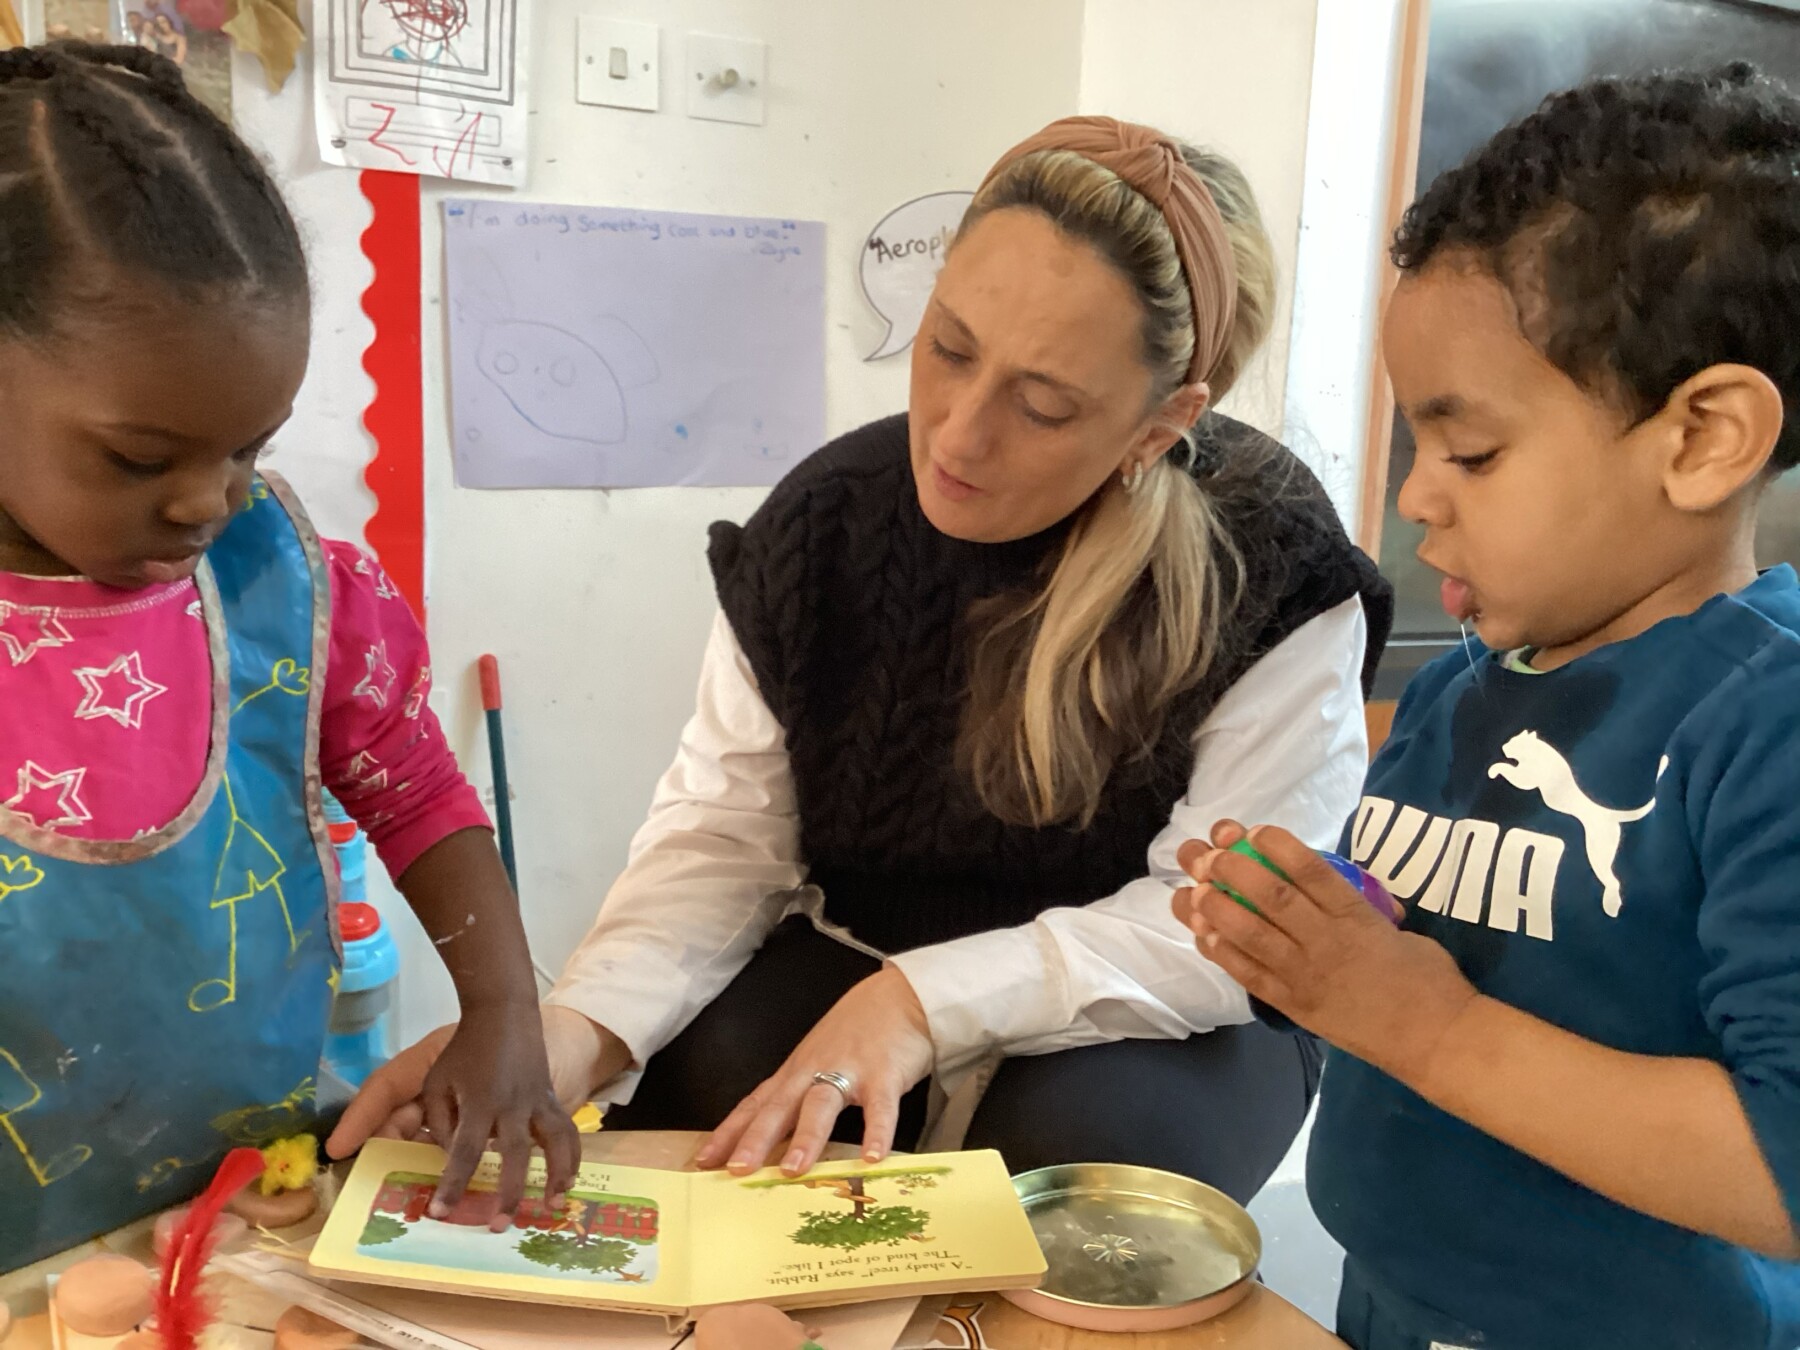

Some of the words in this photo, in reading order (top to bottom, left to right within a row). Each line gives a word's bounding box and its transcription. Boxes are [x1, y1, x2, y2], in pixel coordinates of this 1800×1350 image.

[514, 208, 570, 234] doing
[1351, 796, 1565, 941] PUMA
[830, 1256, 858, 1267] spot
[866, 1255, 881, 1266] of
[887, 1252, 918, 1263] kind
[905, 1262, 945, 1273] shady
[825, 1268, 854, 1279] says
[765, 1273, 819, 1286] Rabbit.
